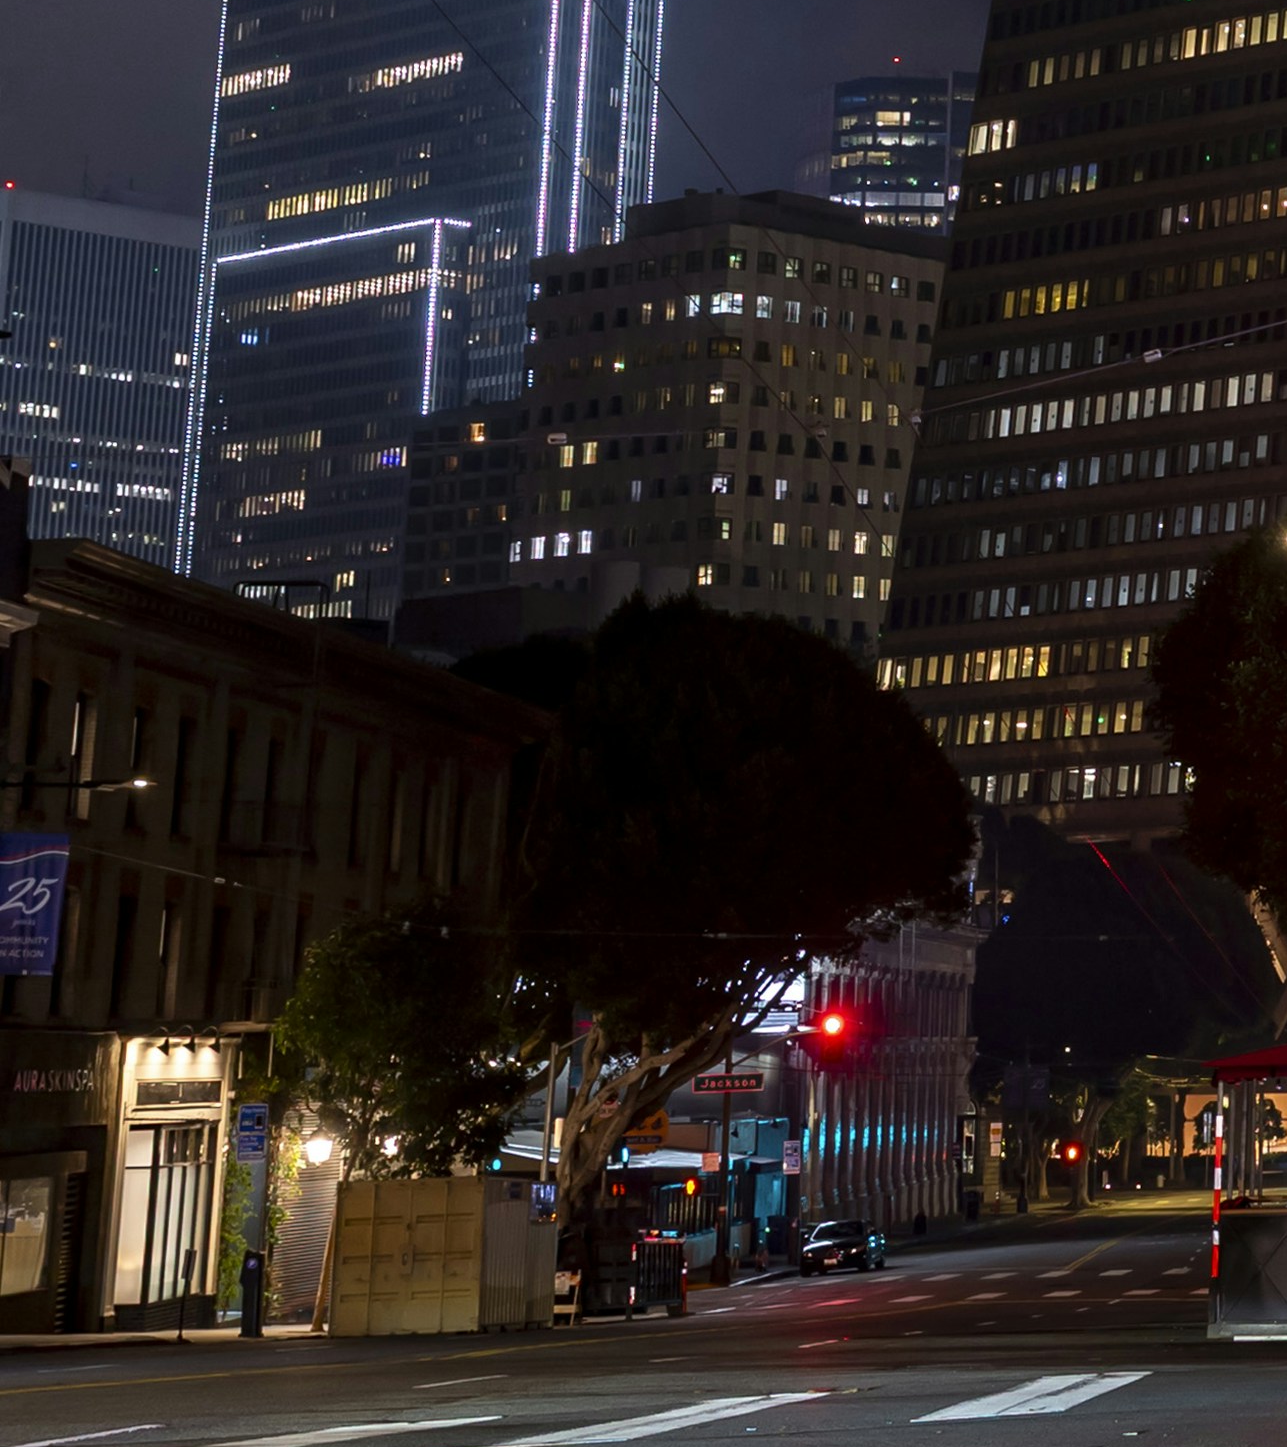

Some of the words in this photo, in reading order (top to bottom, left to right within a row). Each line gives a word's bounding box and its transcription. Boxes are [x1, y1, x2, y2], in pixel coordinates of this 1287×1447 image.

[0, 877, 59, 914] 25
[0, 936, 49, 945] OMMUNITY
[700, 1079, 757, 1089] Jackson
